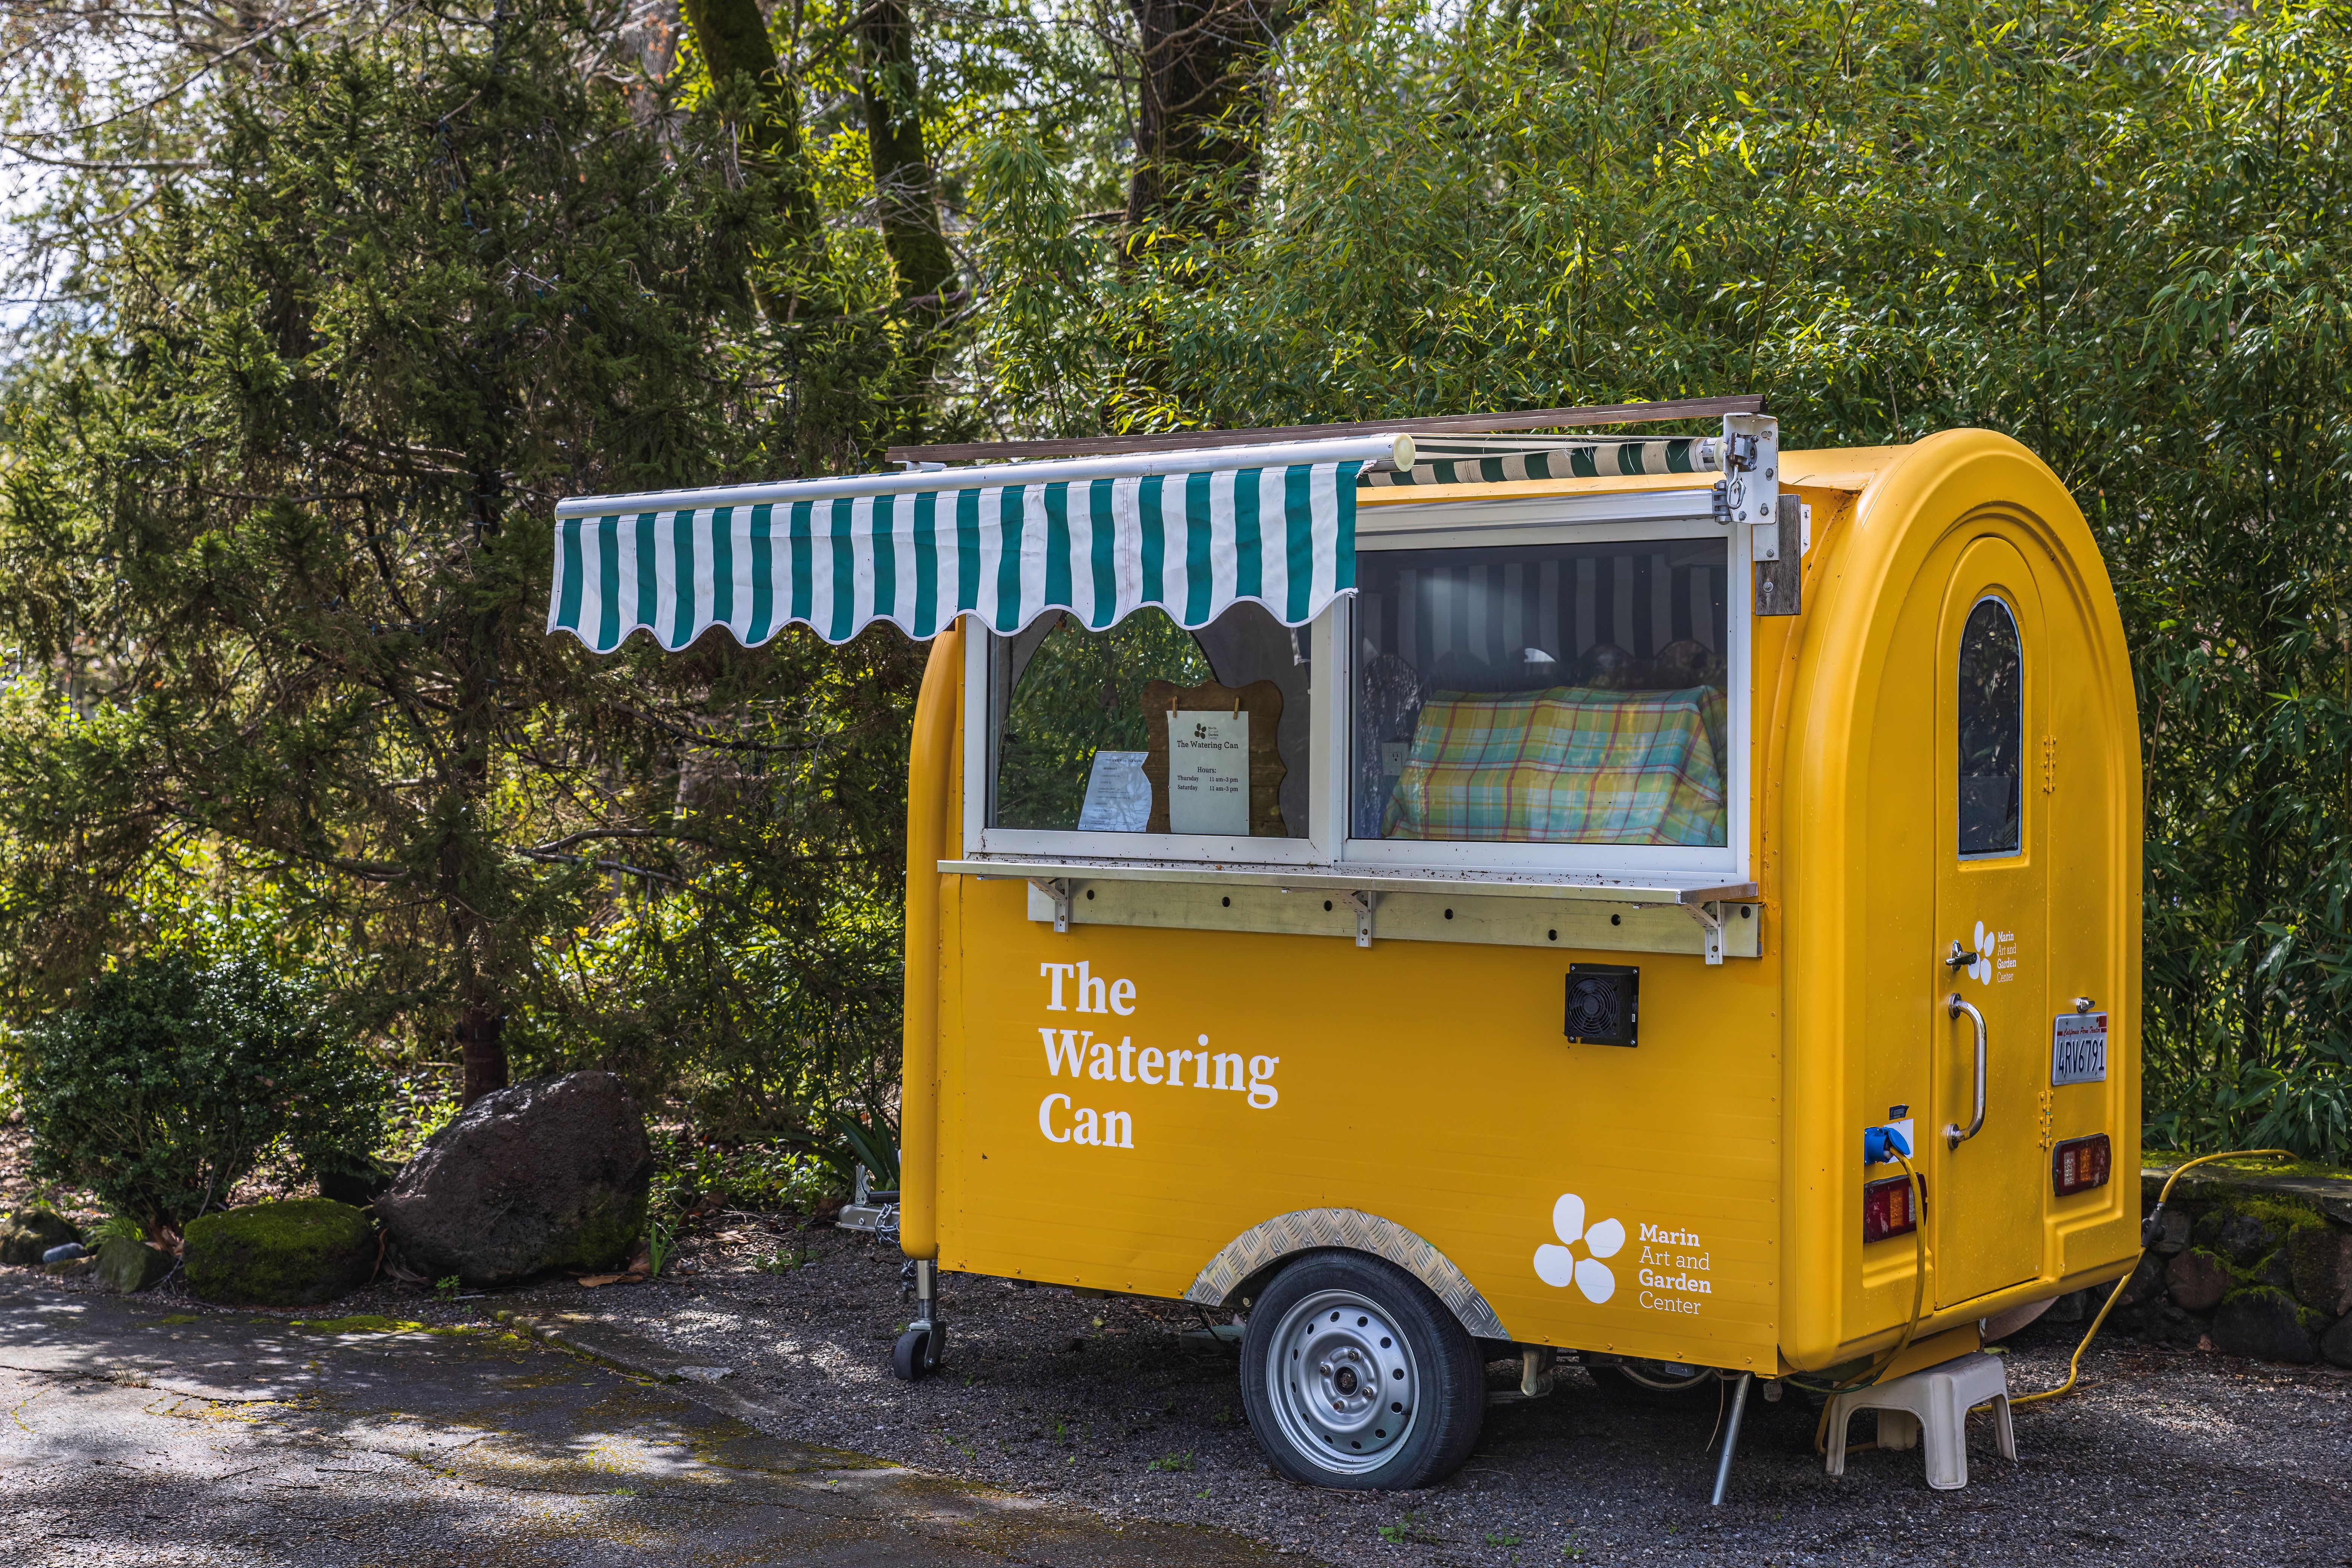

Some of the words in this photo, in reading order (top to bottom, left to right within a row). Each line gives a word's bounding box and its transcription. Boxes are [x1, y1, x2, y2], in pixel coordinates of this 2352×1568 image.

[1190, 741, 1222, 750] Watering
[1998, 931, 2014, 942] Marin
[2007, 943, 2016, 954] and
[1997, 957, 2017, 969] Garden
[1040, 961, 1136, 1015] The
[1997, 972, 2014, 983] Center
[1038, 1028, 1279, 1109] Watering
[2059, 1039, 2104, 1074] 4RV6791
[1039, 1093, 1134, 1148] Can
[1639, 1223, 1700, 1247] Marin
[1639, 1246, 1670, 1266] Art
[1676, 1253, 1710, 1271] and
[1639, 1268, 1712, 1294] Garden
[1640, 1291, 1701, 1315] Center
